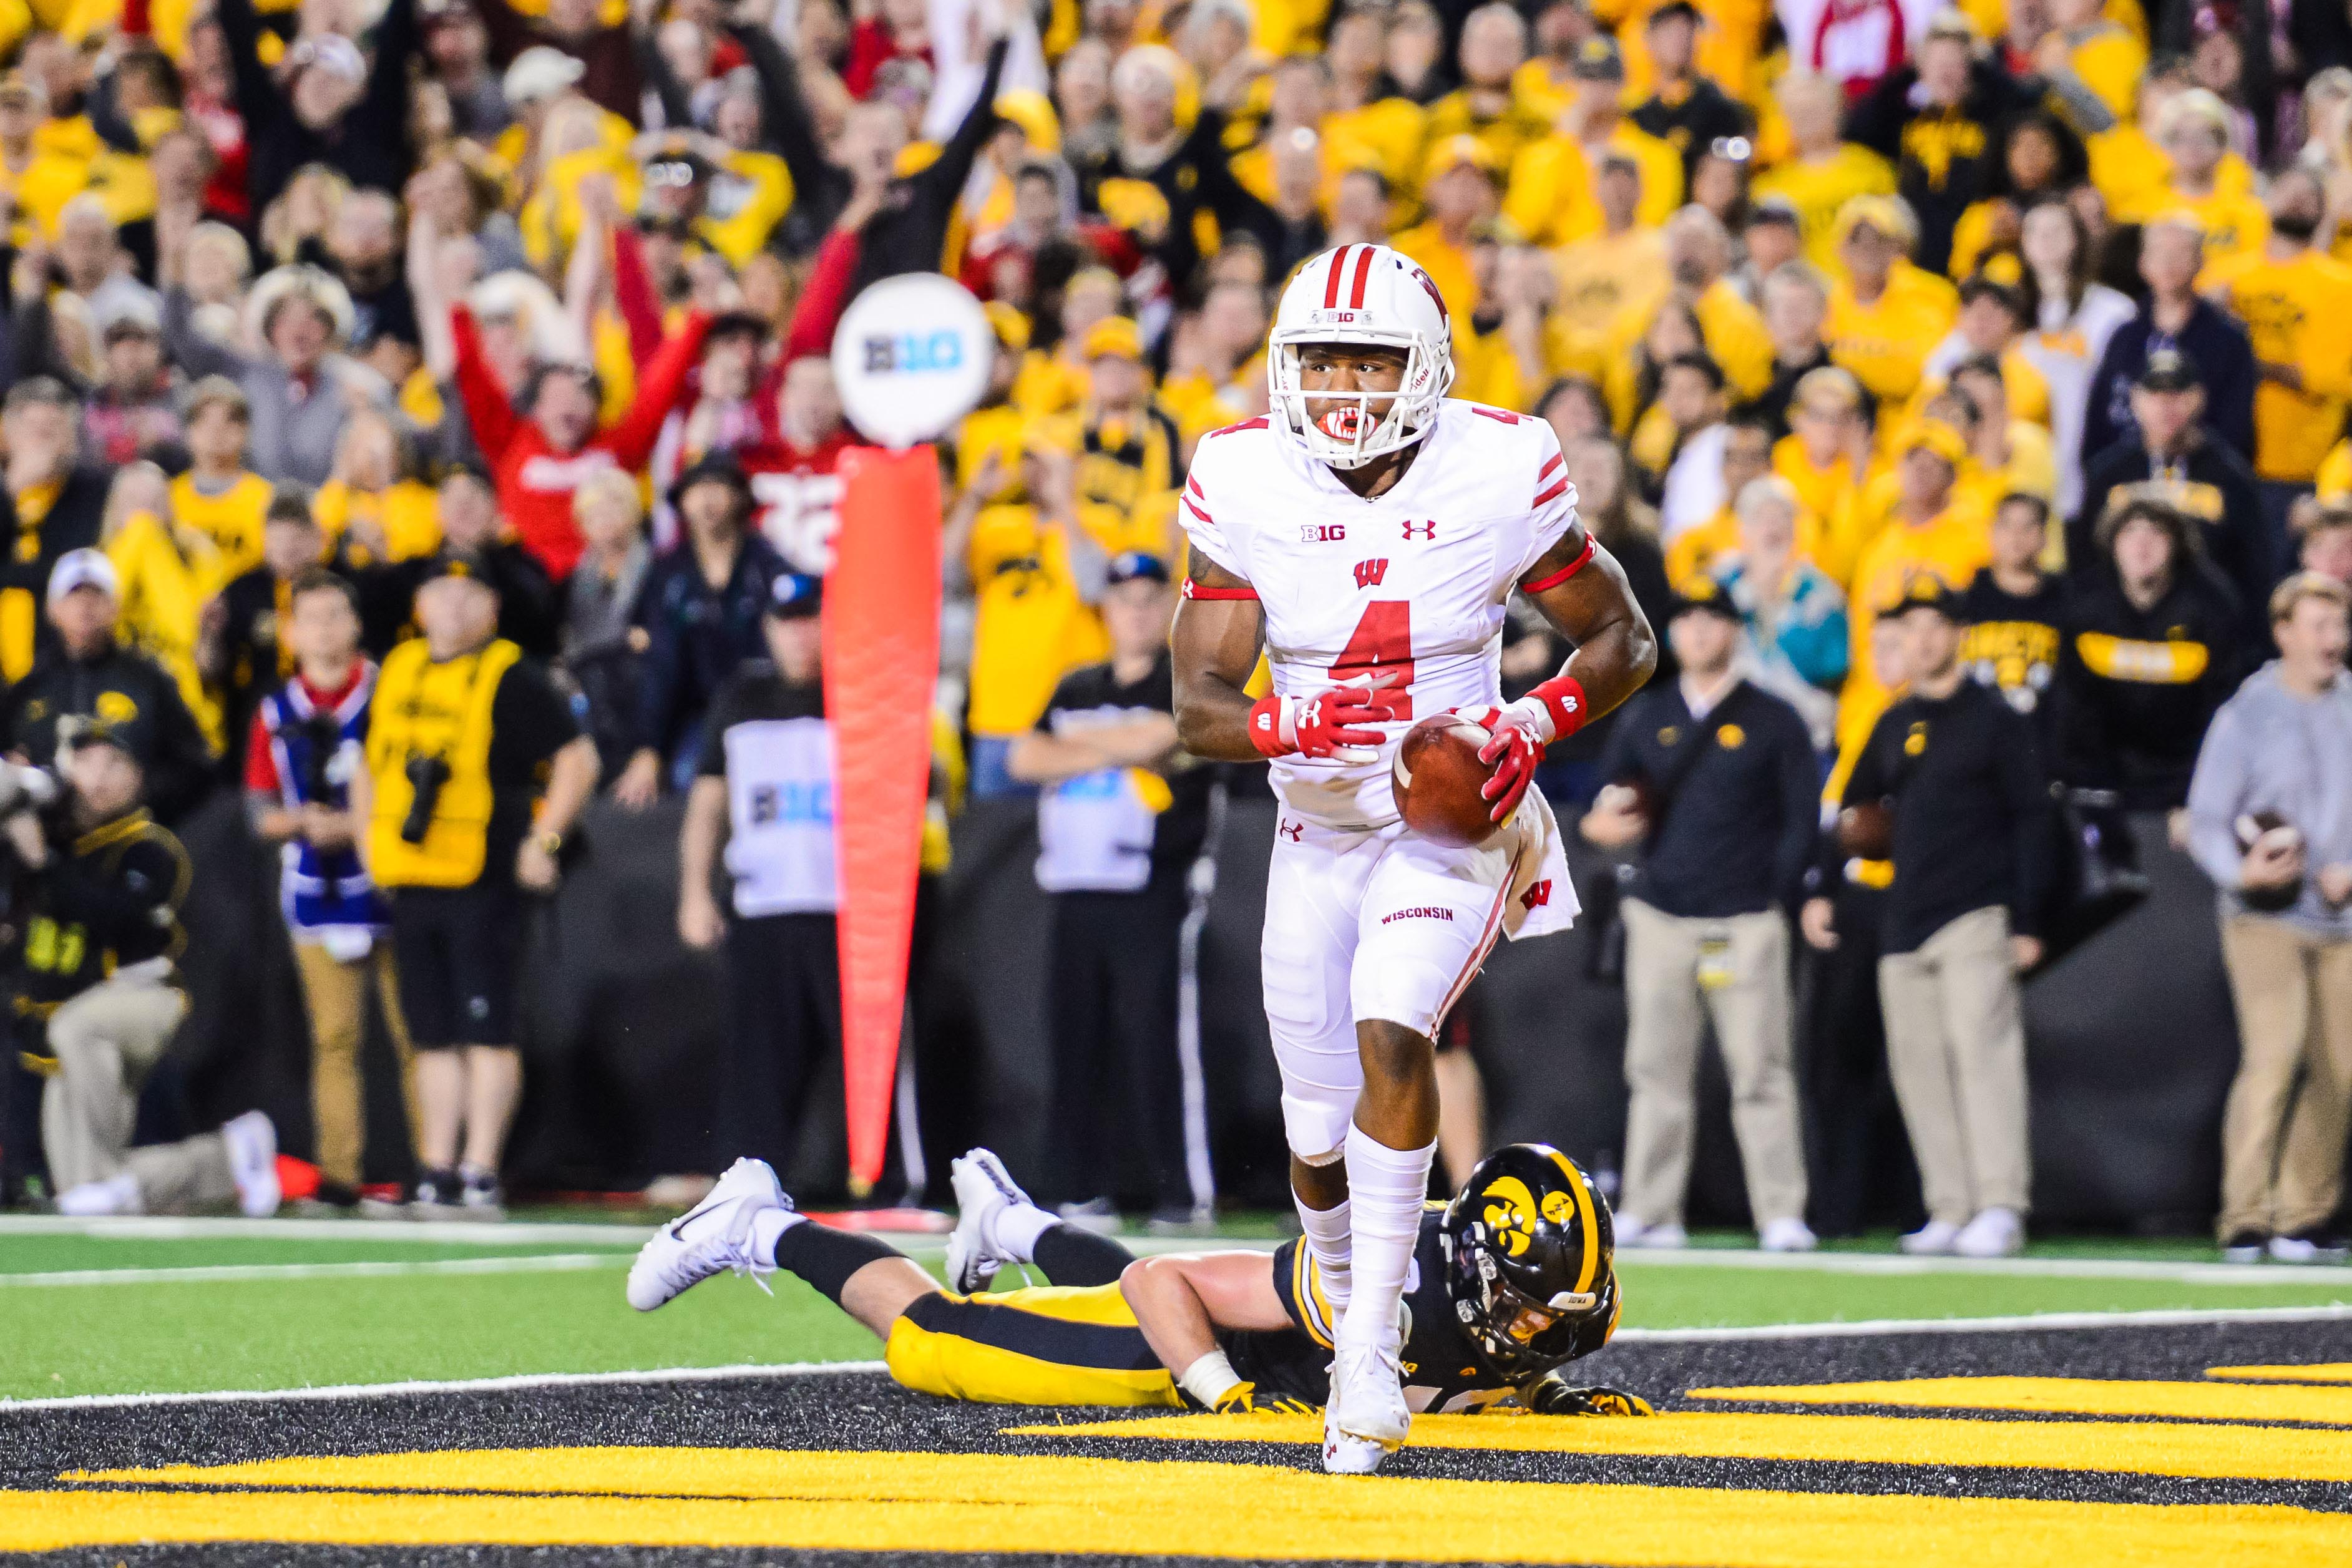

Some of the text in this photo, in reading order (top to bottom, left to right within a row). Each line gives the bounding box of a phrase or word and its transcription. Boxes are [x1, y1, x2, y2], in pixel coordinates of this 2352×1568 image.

[1353, 558, 1389, 590] W
[1327, 600, 1415, 721] 4
[1520, 879, 1552, 911] W
[1381, 907, 1453, 925] WISCONSIN
